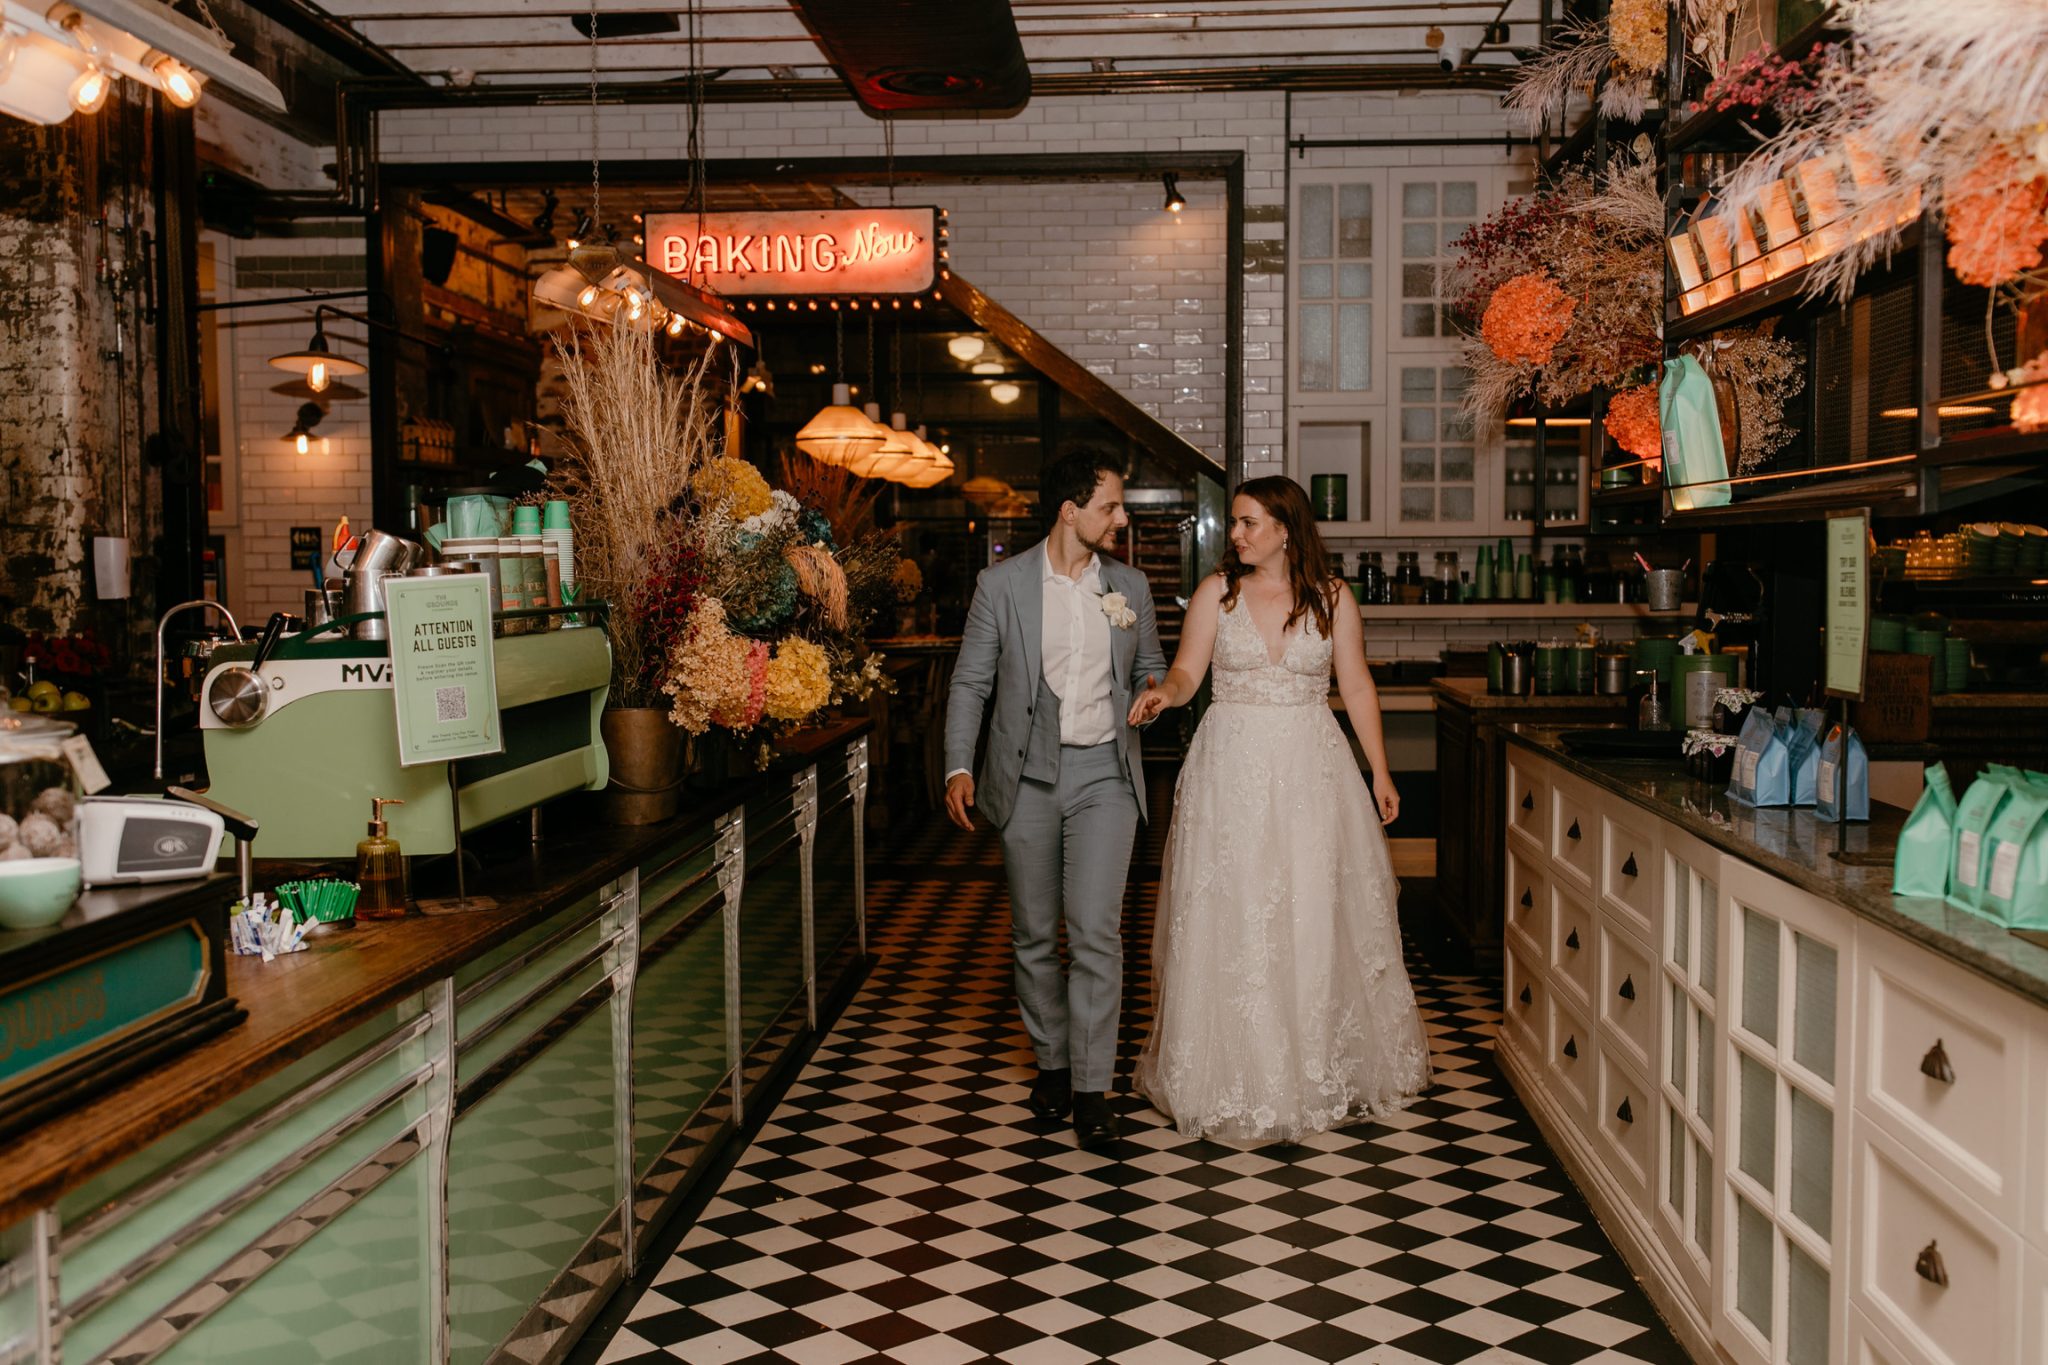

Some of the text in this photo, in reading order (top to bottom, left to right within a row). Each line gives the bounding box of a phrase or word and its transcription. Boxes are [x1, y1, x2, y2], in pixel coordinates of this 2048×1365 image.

[663, 221, 915, 273] BAKING Now
[415, 619, 473, 637] ATTENTION
[413, 635, 476, 652] ALL GUESTS
